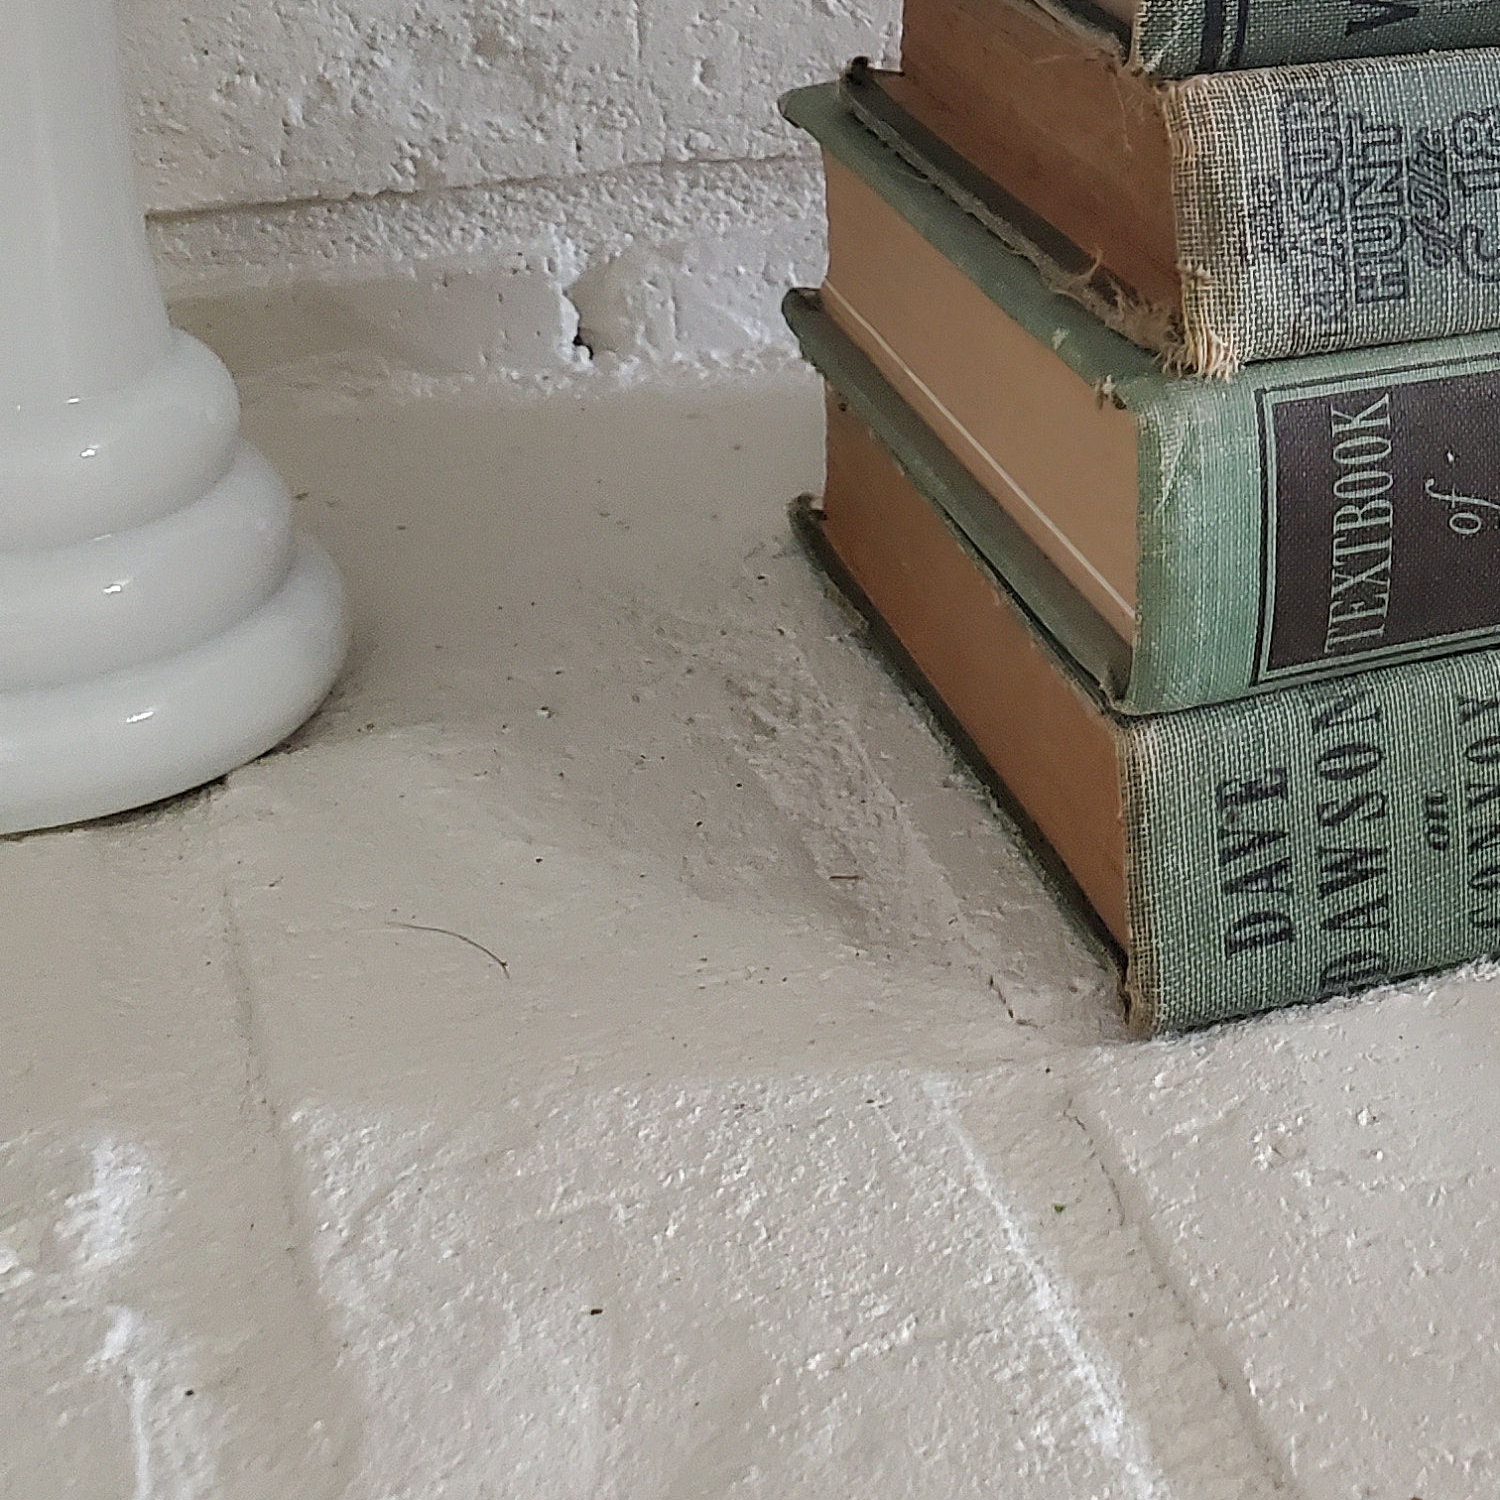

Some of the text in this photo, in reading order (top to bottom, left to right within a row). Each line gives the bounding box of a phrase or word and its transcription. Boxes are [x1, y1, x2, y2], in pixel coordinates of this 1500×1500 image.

[1348, 113, 1409, 304] HUNT
[1324, 392, 1395, 655] TEXTBOOK
[1216, 764, 1296, 960] DAVE
[1311, 684, 1392, 992] DAWSON
[1423, 792, 1450, 852] on
